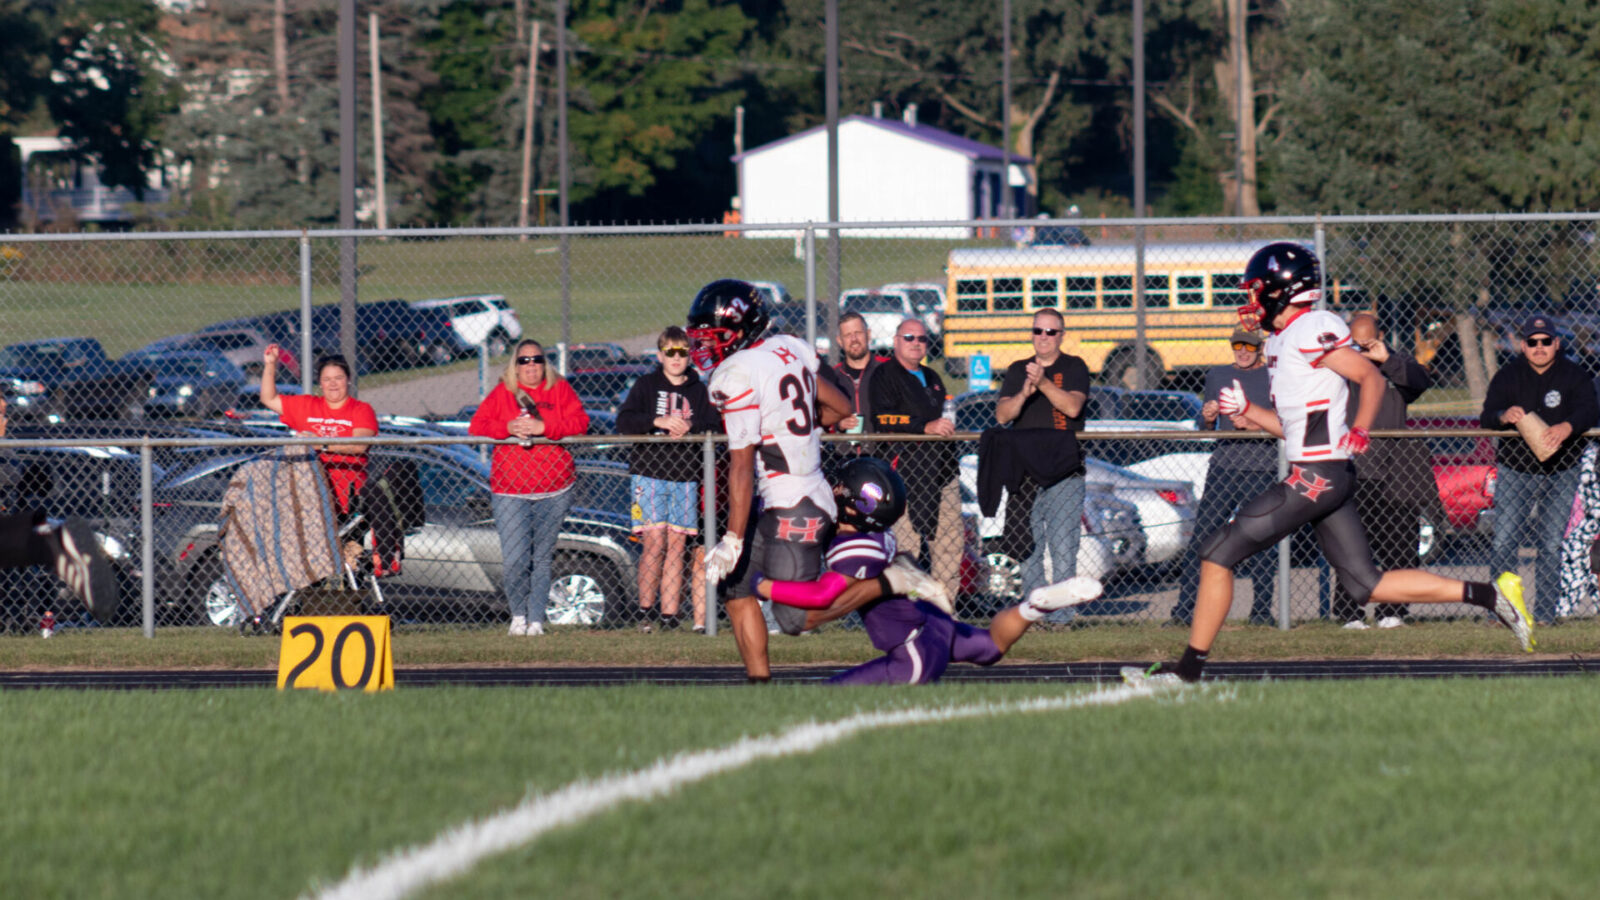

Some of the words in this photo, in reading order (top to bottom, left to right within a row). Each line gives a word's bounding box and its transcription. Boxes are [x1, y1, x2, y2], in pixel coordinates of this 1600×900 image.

[1267, 255, 1279, 272] 4
[729, 296, 749, 323] 32
[1283, 463, 1334, 503] H
[775, 515, 825, 543] H
[854, 566, 867, 579] 4
[284, 622, 376, 690] 20
